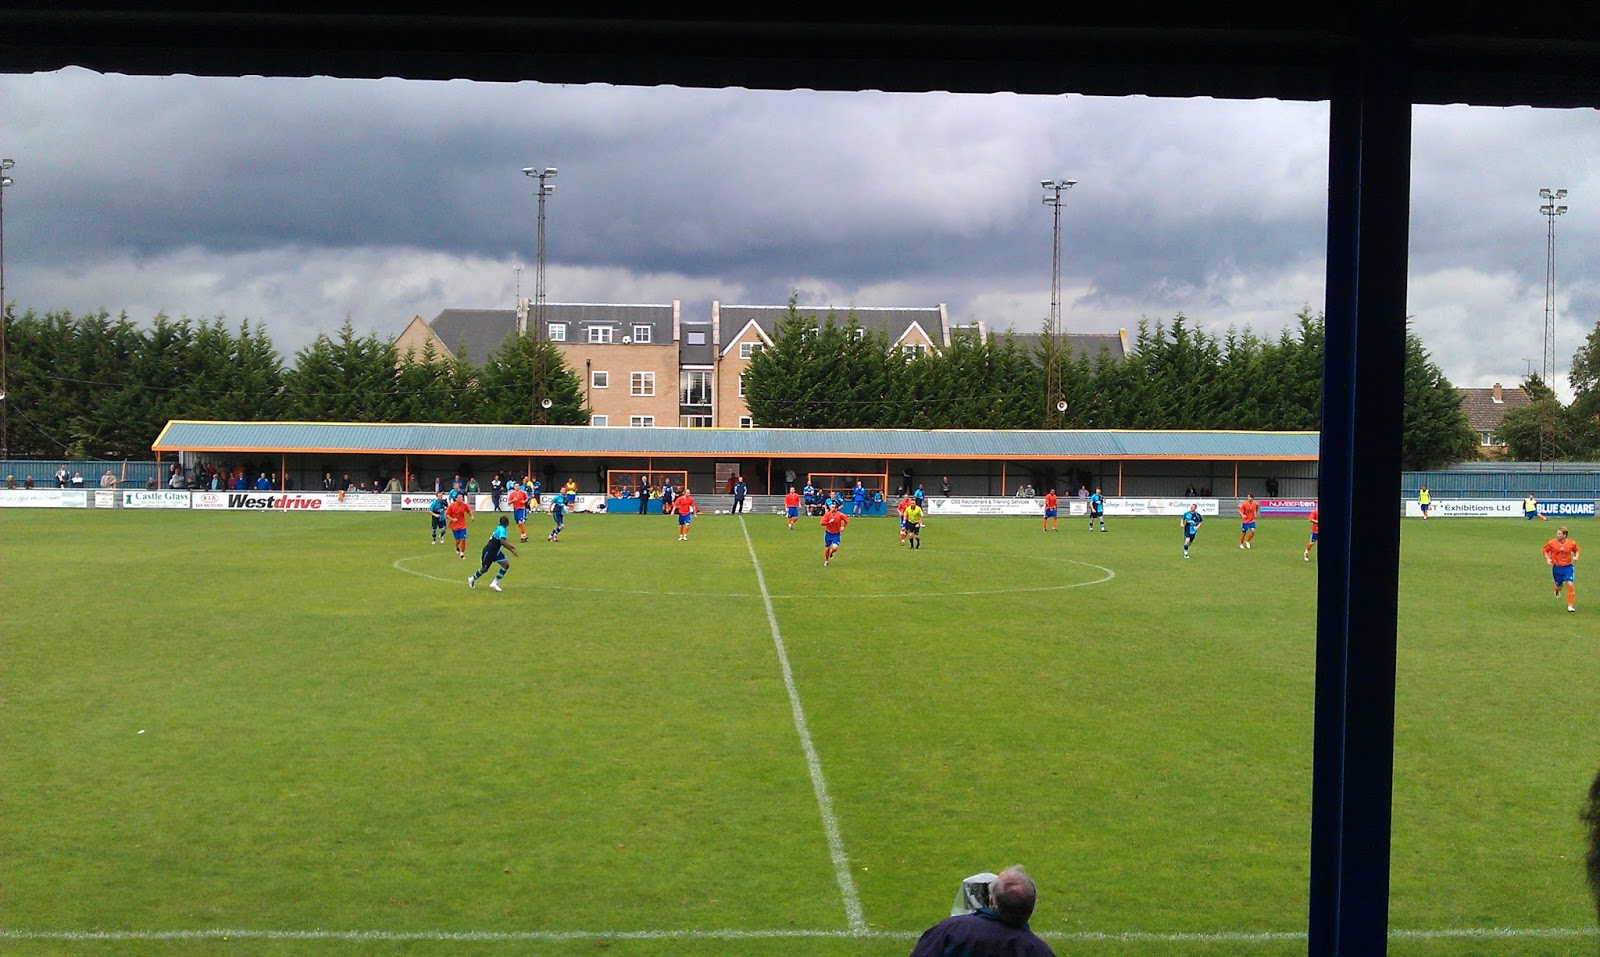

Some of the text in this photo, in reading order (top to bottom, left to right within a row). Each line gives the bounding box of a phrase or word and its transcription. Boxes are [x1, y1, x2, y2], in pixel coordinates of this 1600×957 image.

[135, 492, 188, 500] Castle Glass
[228, 494, 322, 509] Westdrive
[1536, 503, 1594, 514] BLUE SQUARE
